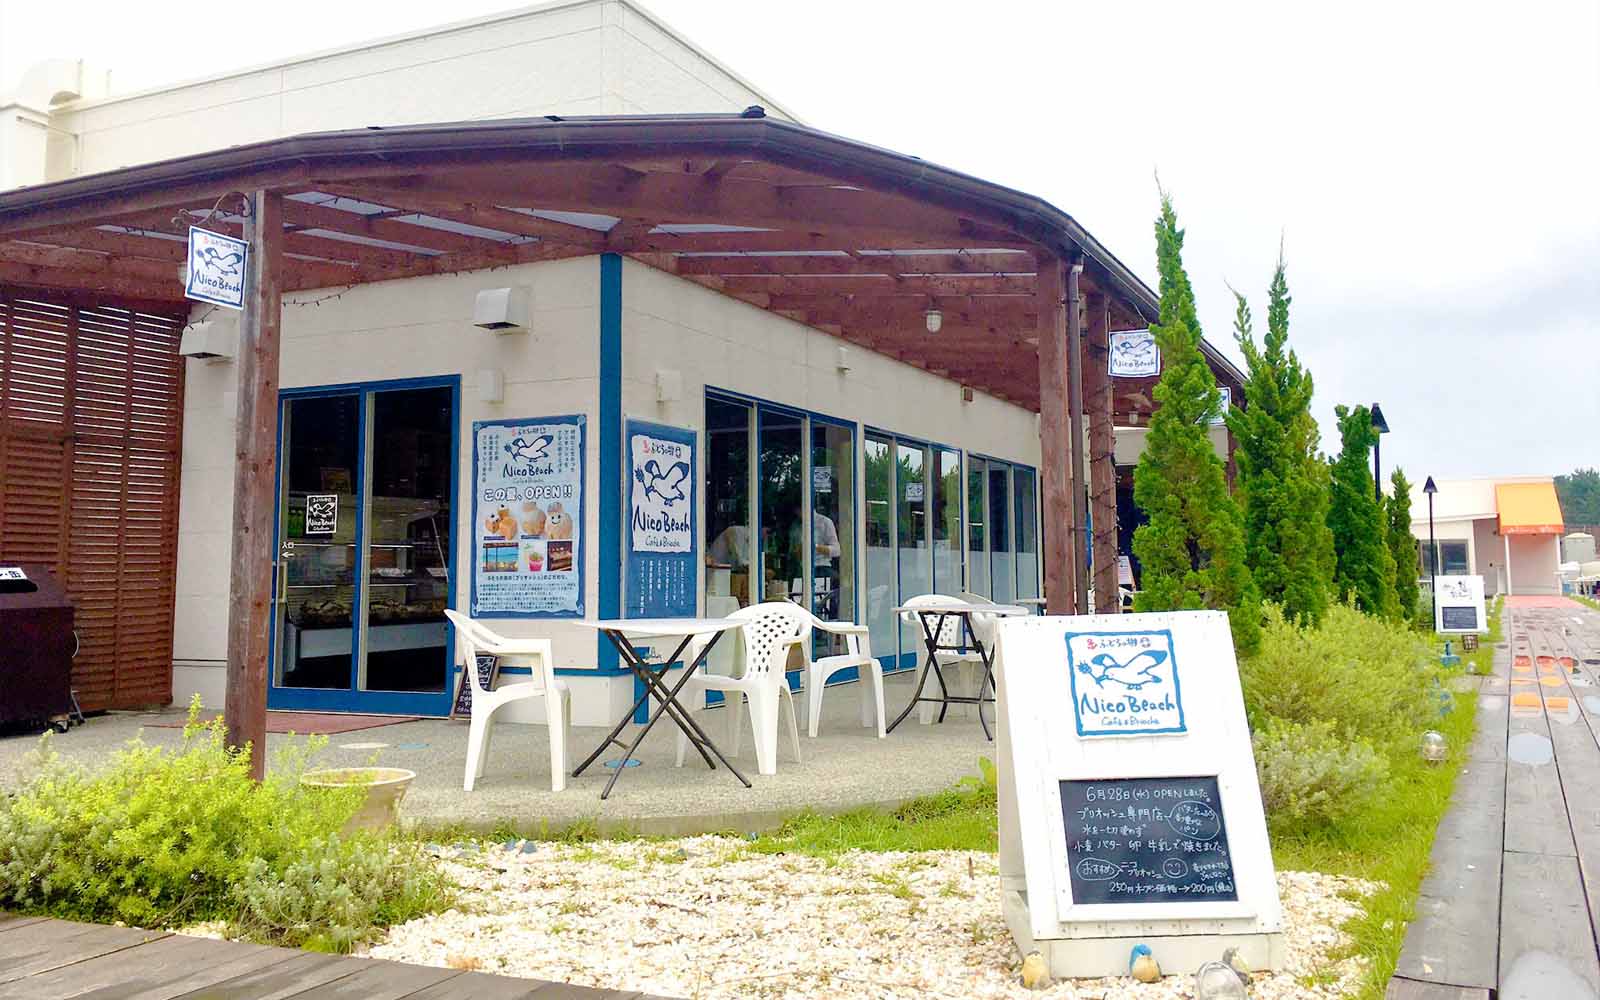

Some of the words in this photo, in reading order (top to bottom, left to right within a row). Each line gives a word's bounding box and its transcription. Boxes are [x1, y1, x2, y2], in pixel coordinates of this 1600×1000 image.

[503, 463, 527, 478] Nico
[526, 462, 554, 477] Beach
[633, 504, 662, 532] Nico
[661, 510, 690, 533] Beach
[282, 541, 294, 549] 入口
[1081, 693, 1126, 715] Nico
[1123, 692, 1176, 713] Beach
